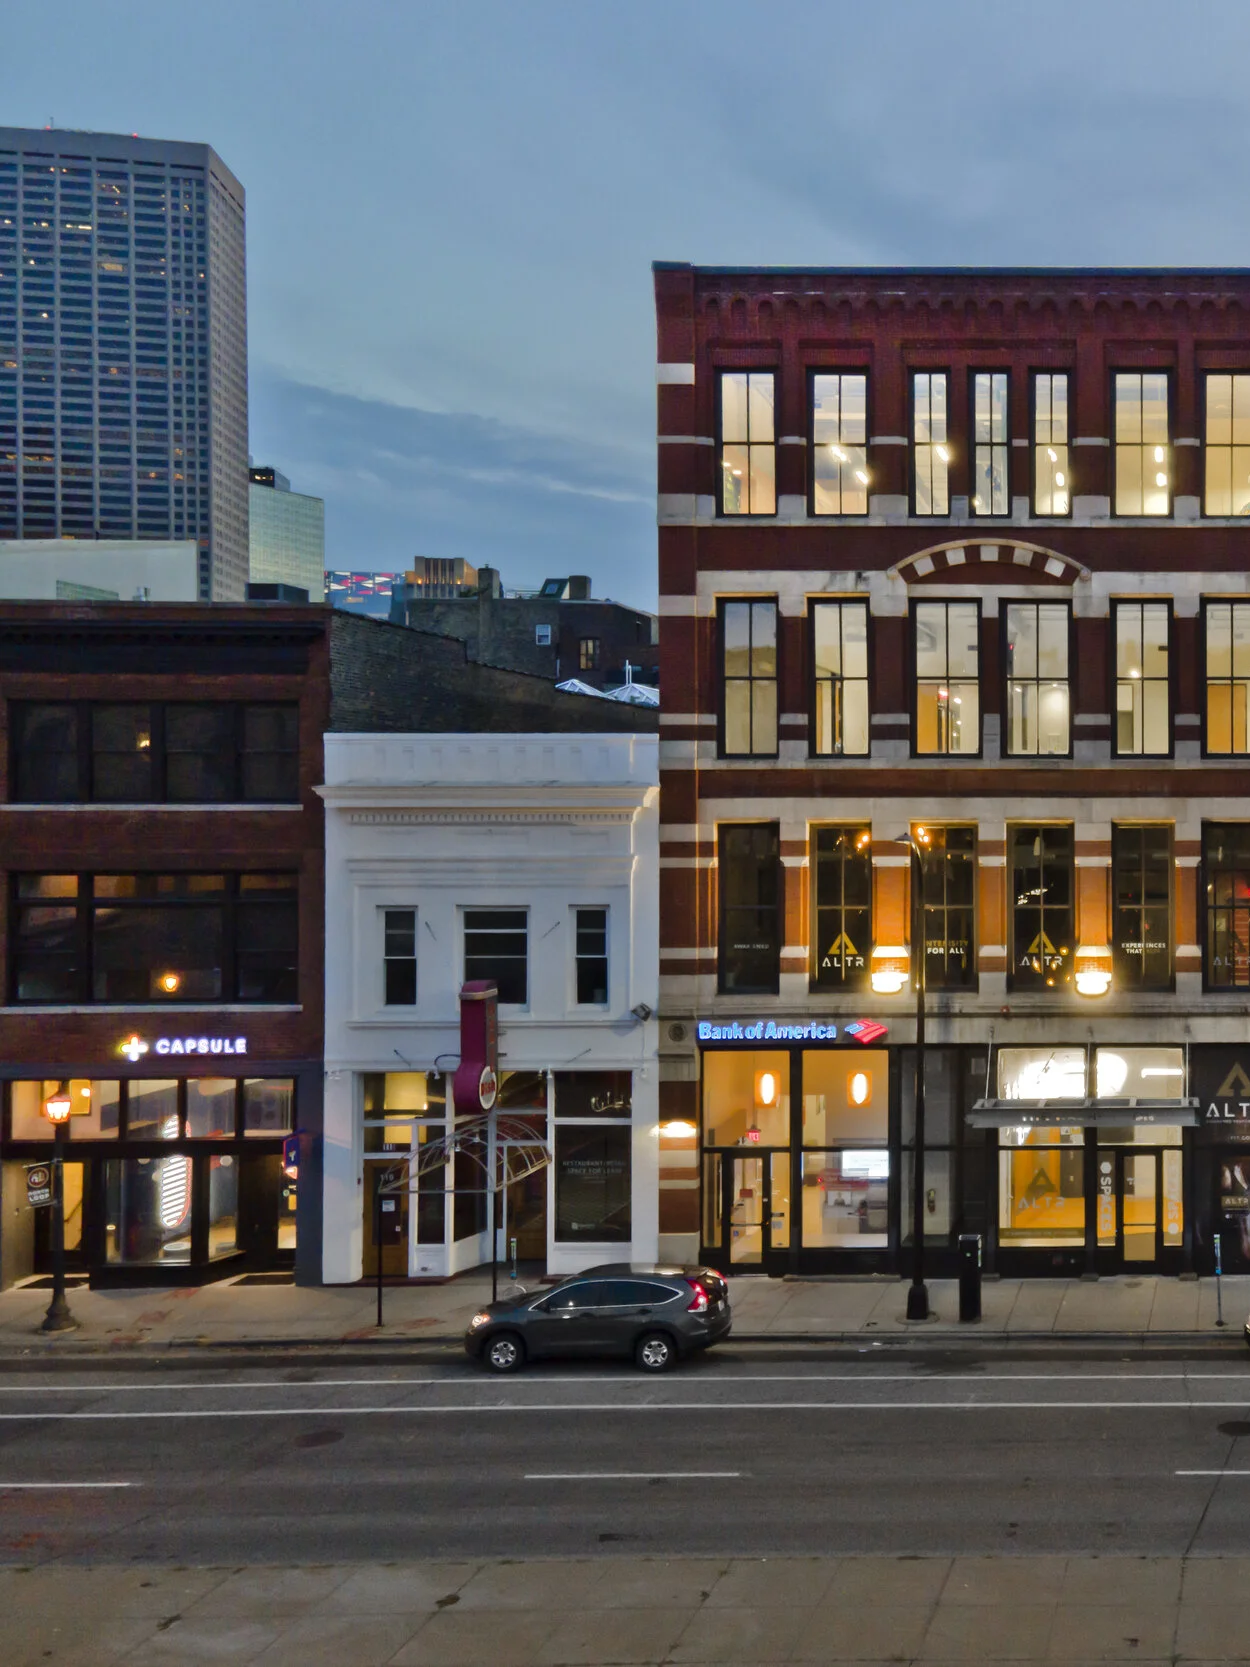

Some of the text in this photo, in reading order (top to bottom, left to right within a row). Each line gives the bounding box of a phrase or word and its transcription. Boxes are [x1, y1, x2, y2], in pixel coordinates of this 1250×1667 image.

[822, 957, 864, 967] ALTR
[1020, 956, 1063, 966] ALTR
[699, 1022, 837, 1039] Bank of America
[156, 1038, 247, 1054] CAPSULE
[29, 1193, 50, 1202] LOOP
[1018, 1196, 1066, 1209] ALTR
[1100, 1176, 1112, 1232] SPACES
